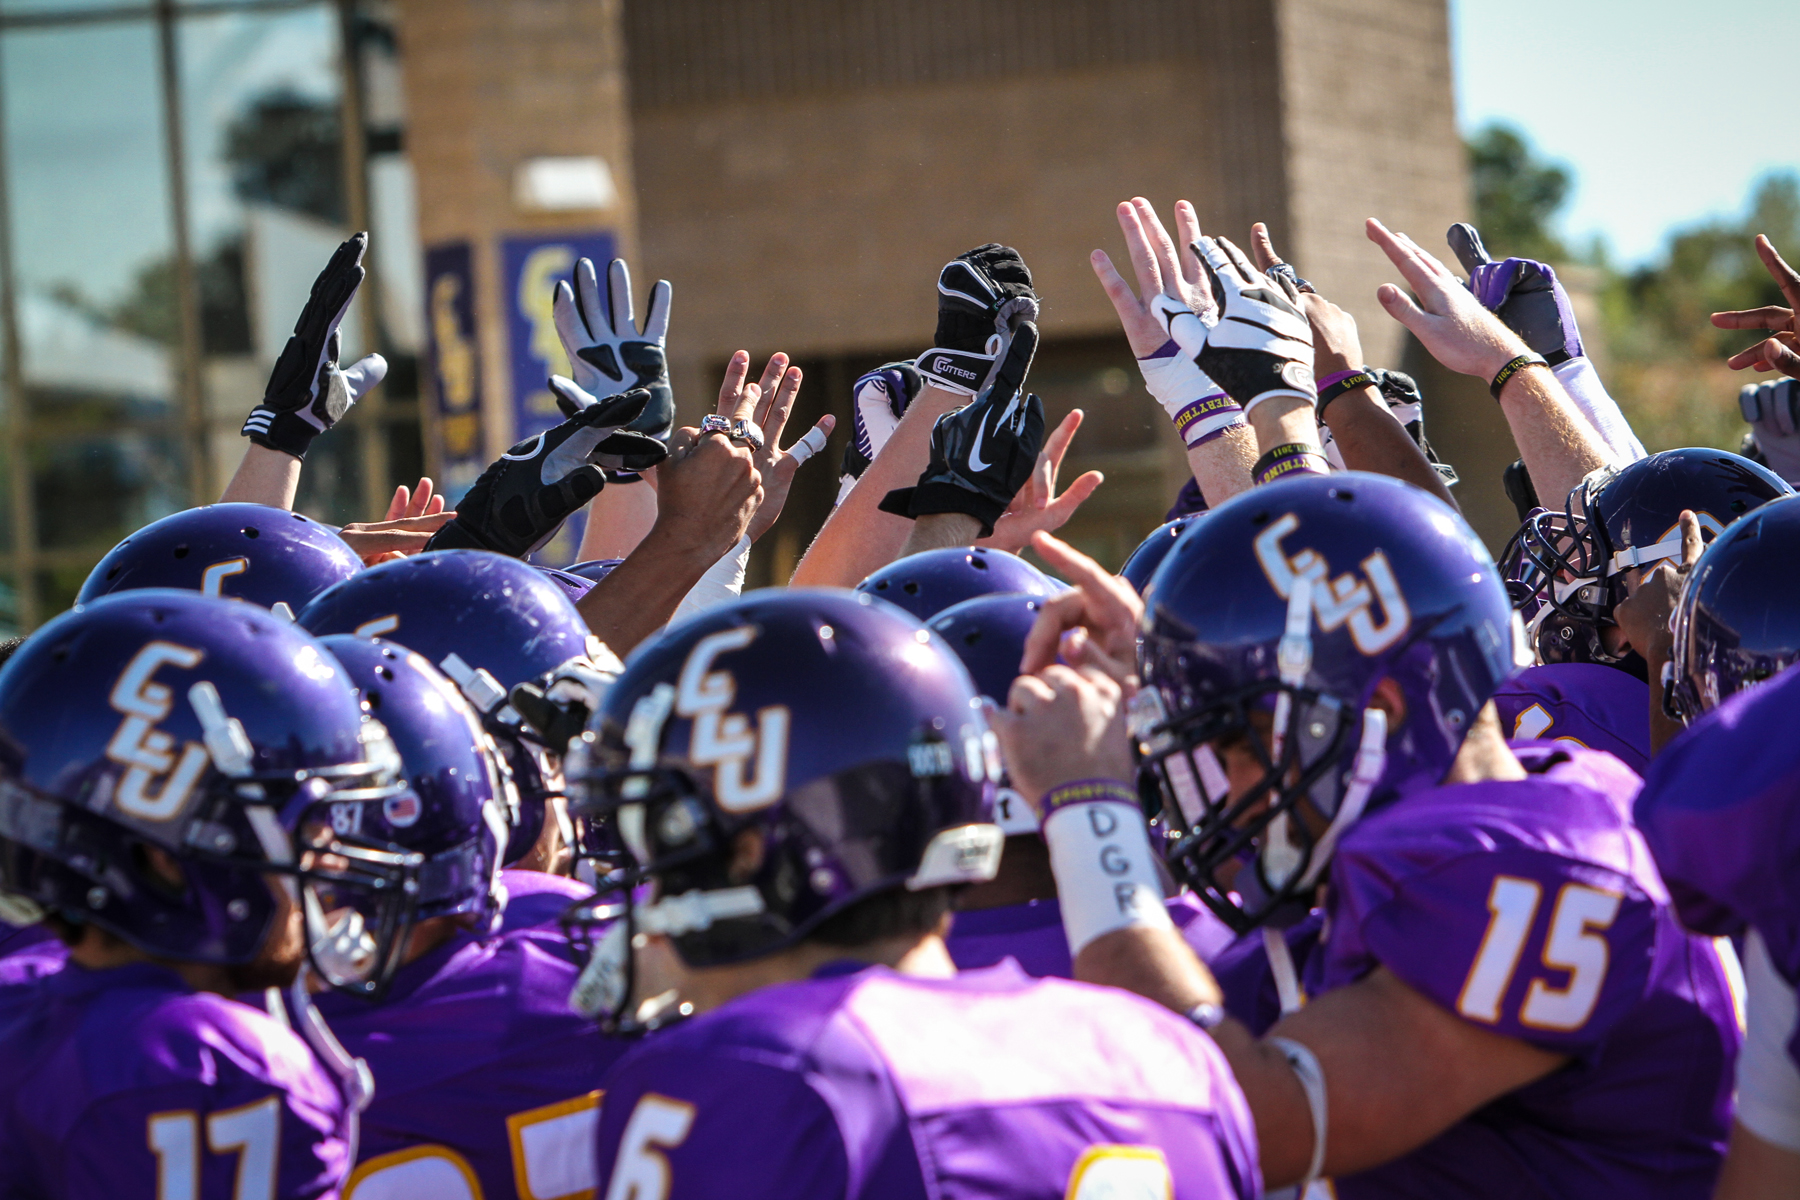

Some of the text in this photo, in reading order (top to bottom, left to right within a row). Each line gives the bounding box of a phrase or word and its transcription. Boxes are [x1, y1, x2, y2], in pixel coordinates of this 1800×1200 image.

[932, 356, 977, 380] CUTTERS
[330, 802, 364, 835] 87
[1455, 874, 1624, 1032] 15
[147, 1095, 280, 1200] 17
